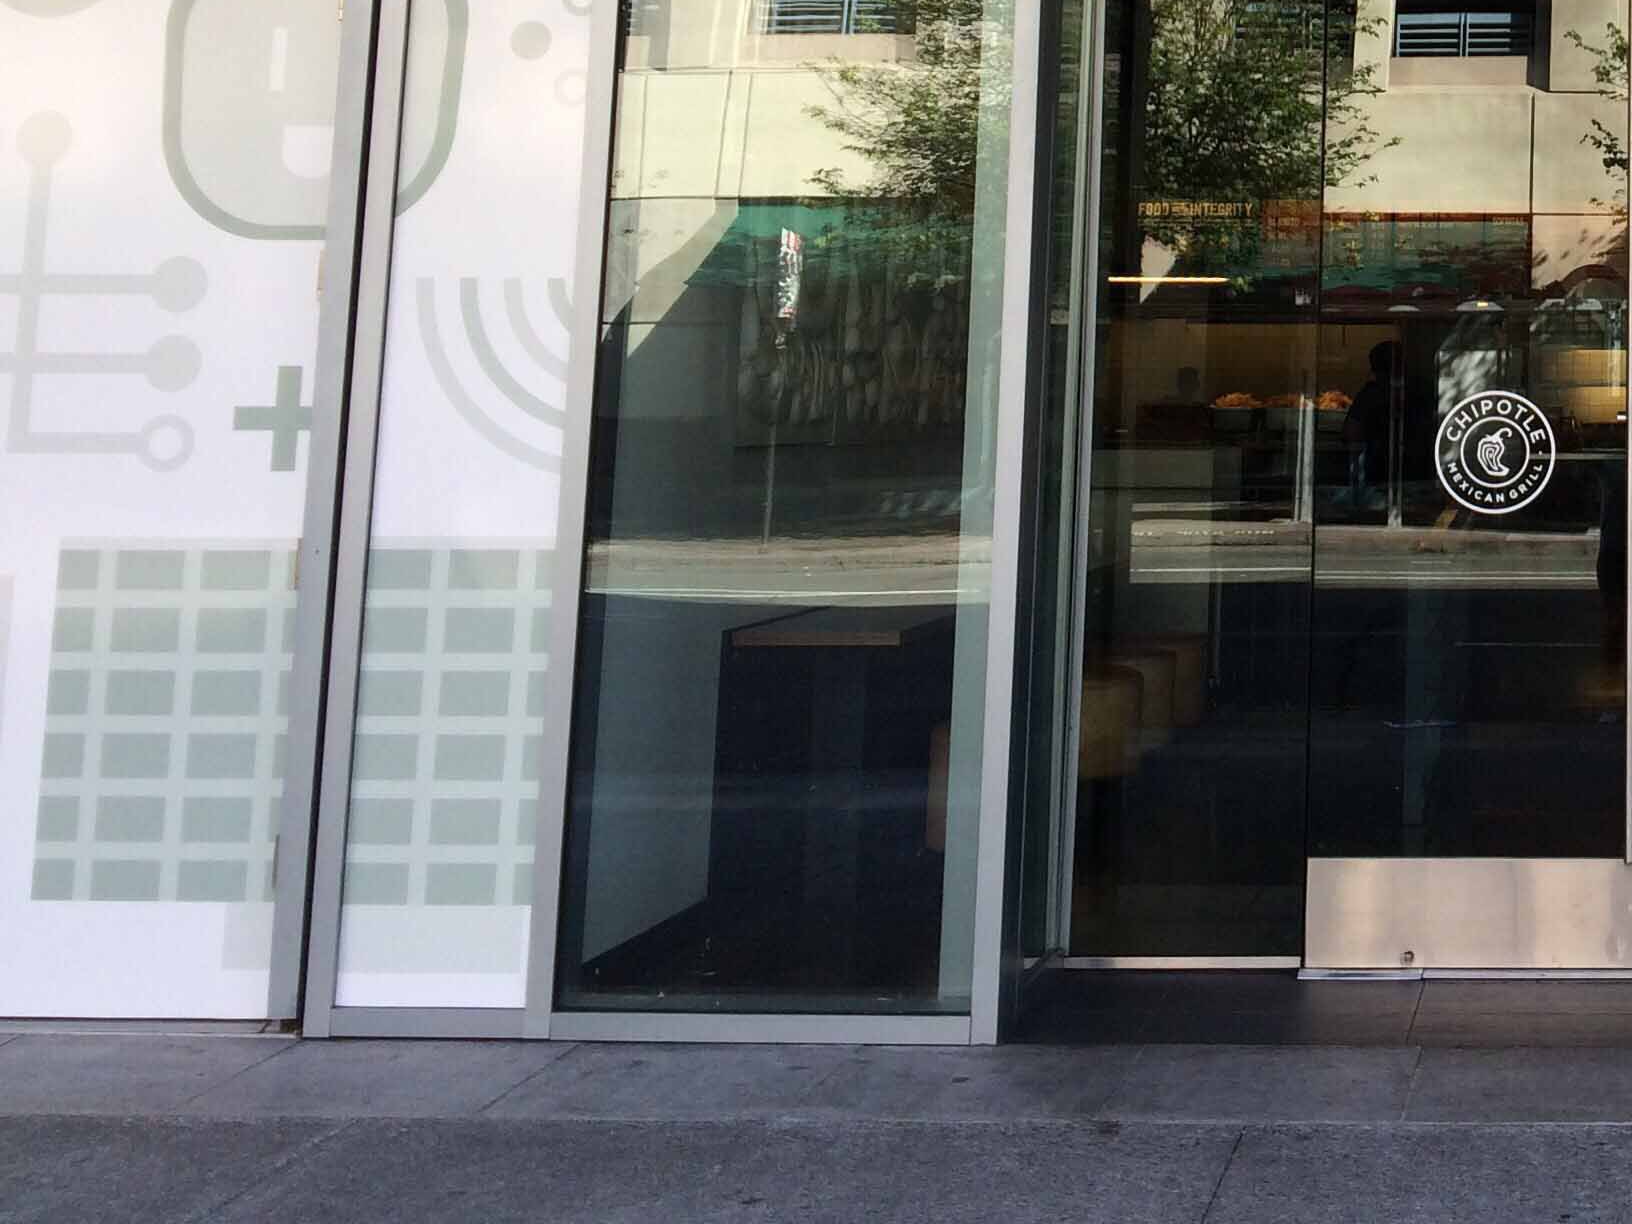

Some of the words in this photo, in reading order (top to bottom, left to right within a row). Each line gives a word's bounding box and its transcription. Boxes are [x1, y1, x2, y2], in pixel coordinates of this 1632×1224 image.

[1446, 399, 1547, 444] CHIPOTLE
[1447, 462, 1505, 503] MEXICAN
[1509, 463, 1543, 499] GRILL
